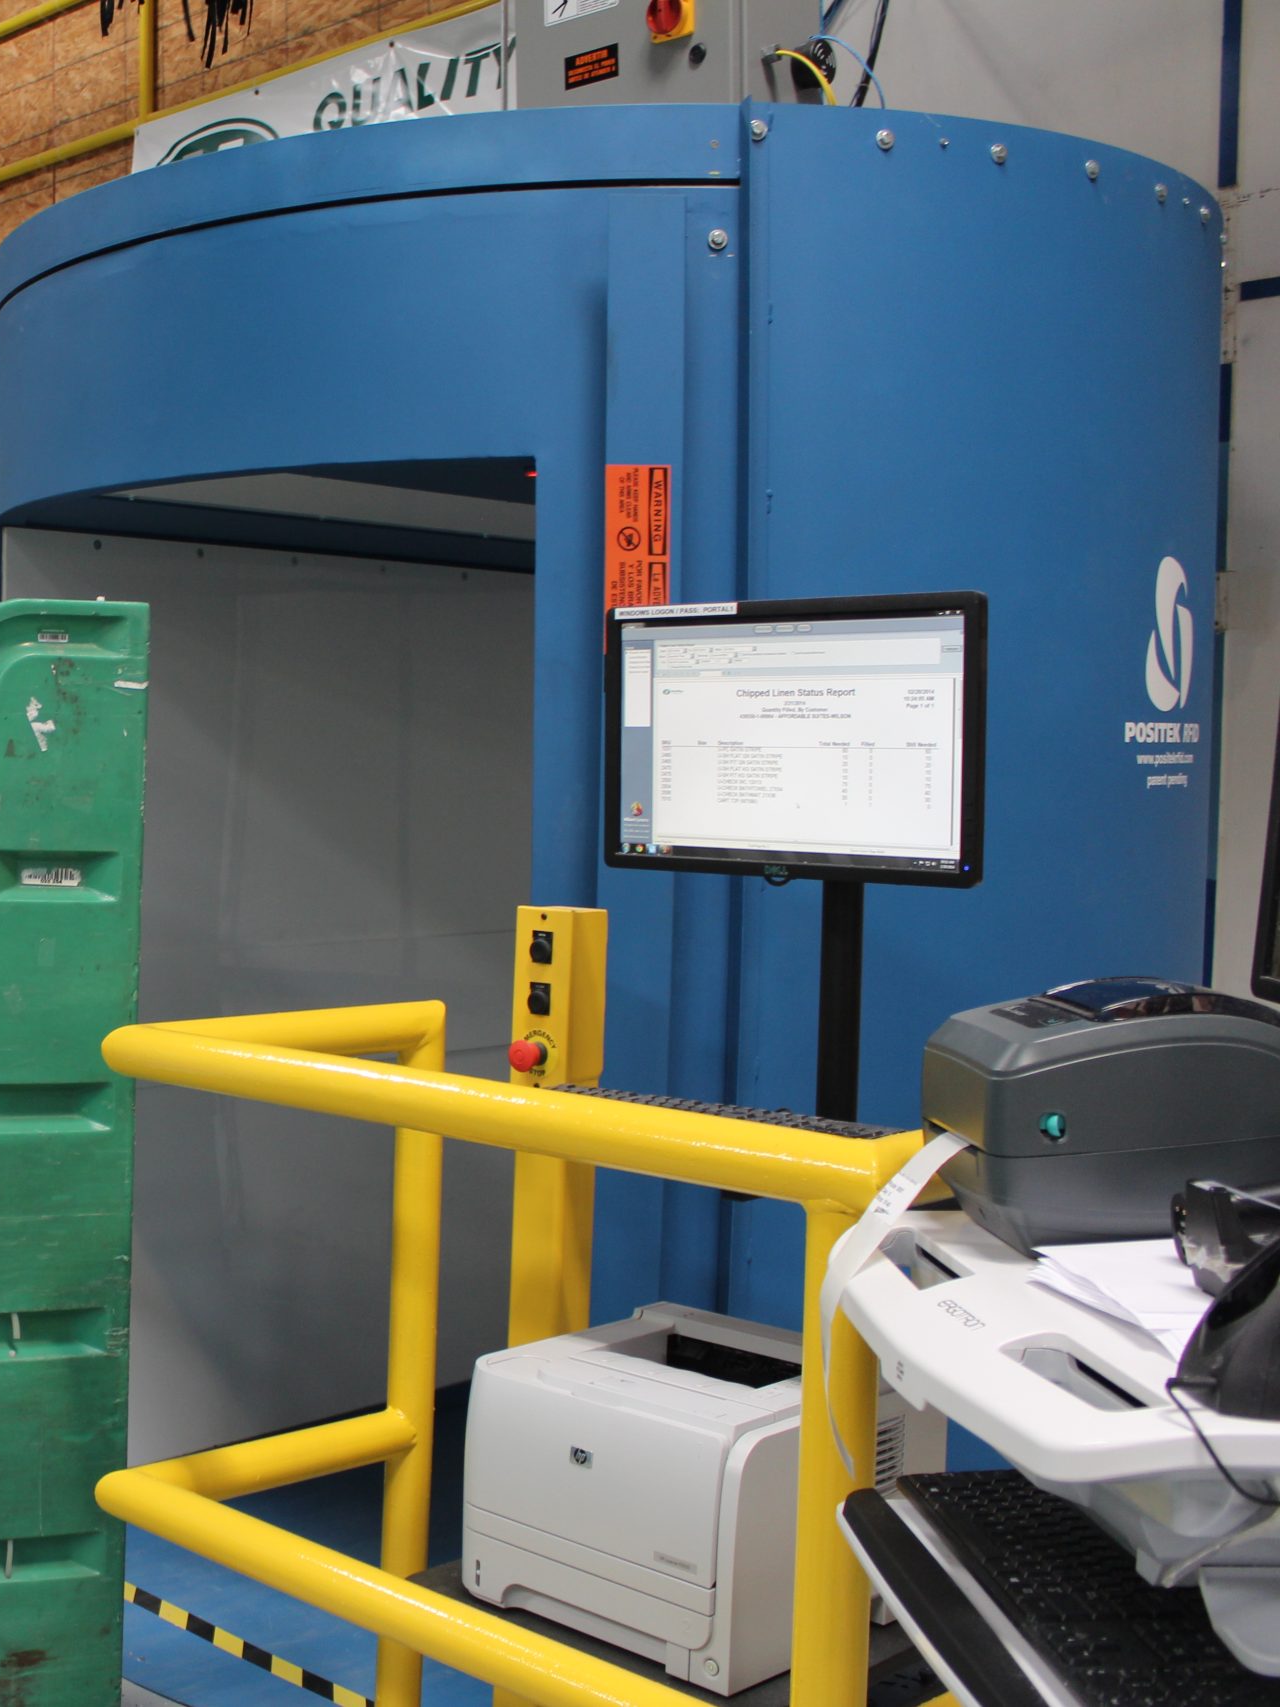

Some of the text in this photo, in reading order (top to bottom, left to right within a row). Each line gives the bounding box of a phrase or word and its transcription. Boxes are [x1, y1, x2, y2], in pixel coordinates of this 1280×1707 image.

[313, 33, 517, 131] QUALITY
[653, 480, 662, 542] WARNING
[653, 586, 662, 606] ADVE
[619, 609, 650, 617] WINDOWS
[651, 608, 675, 616] LOGON
[736, 688, 856, 699] Chipped Linen Status Report
[1124, 721, 1181, 743] POSITEK
[524, 1029, 558, 1049] MERGENCY
